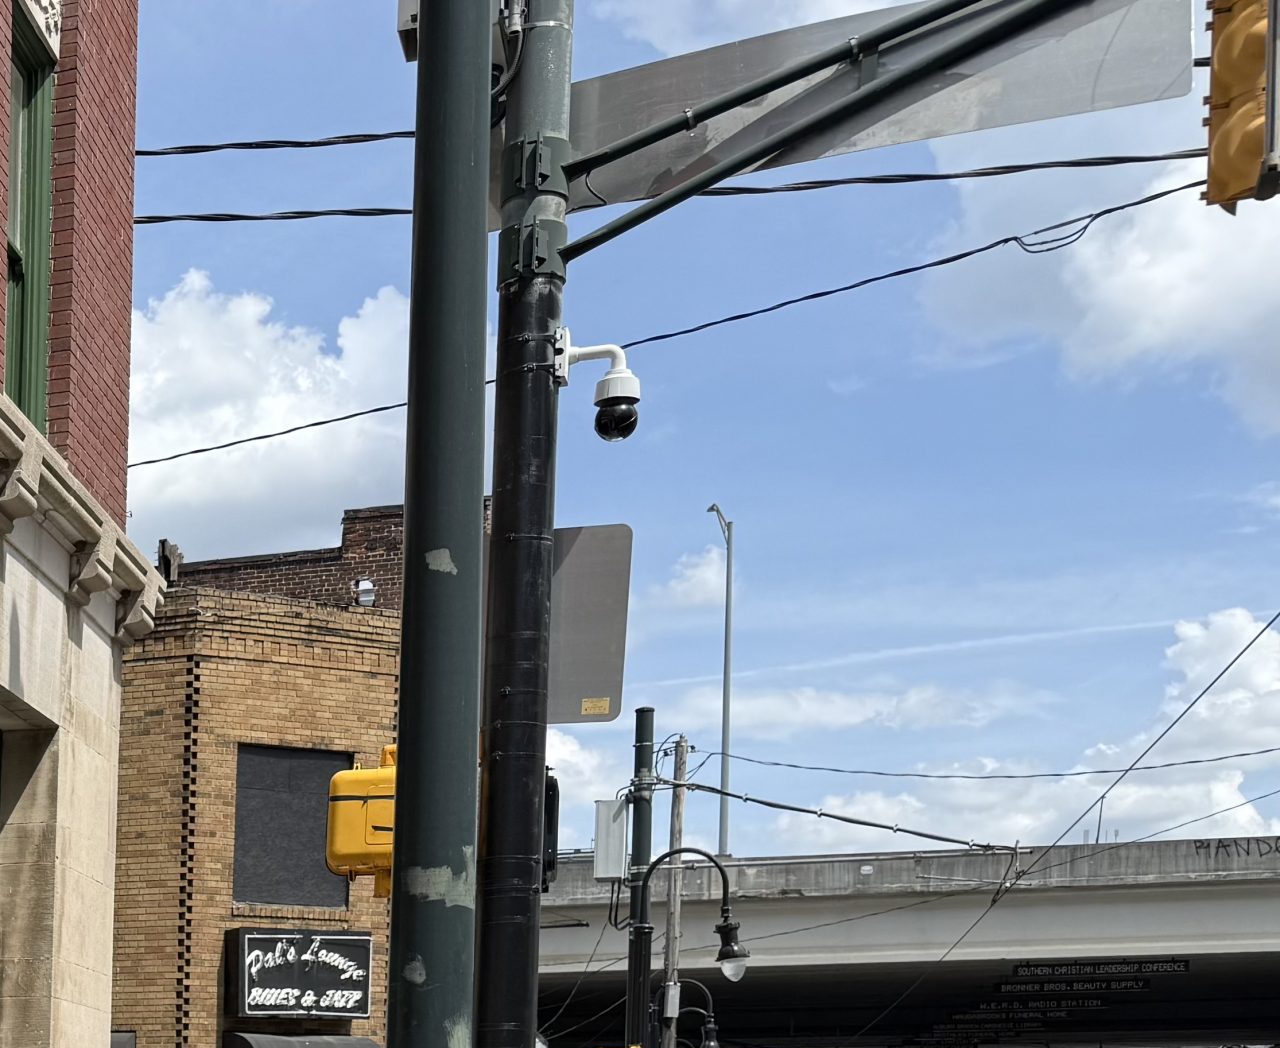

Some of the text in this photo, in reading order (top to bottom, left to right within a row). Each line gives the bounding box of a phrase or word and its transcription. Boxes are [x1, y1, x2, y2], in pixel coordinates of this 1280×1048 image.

[301, 938, 367, 981] Lounge
[1017, 962, 1185, 976] SOUTHERN CHRISTIAN LEADERSHIP CONFERENCE
[1001, 981, 1144, 992] BRONNER BROS. BEAUTY SUPPLY
[247, 987, 363, 1008] BLUES & JAZZ
[1061, 999, 1101, 1007] STATION
